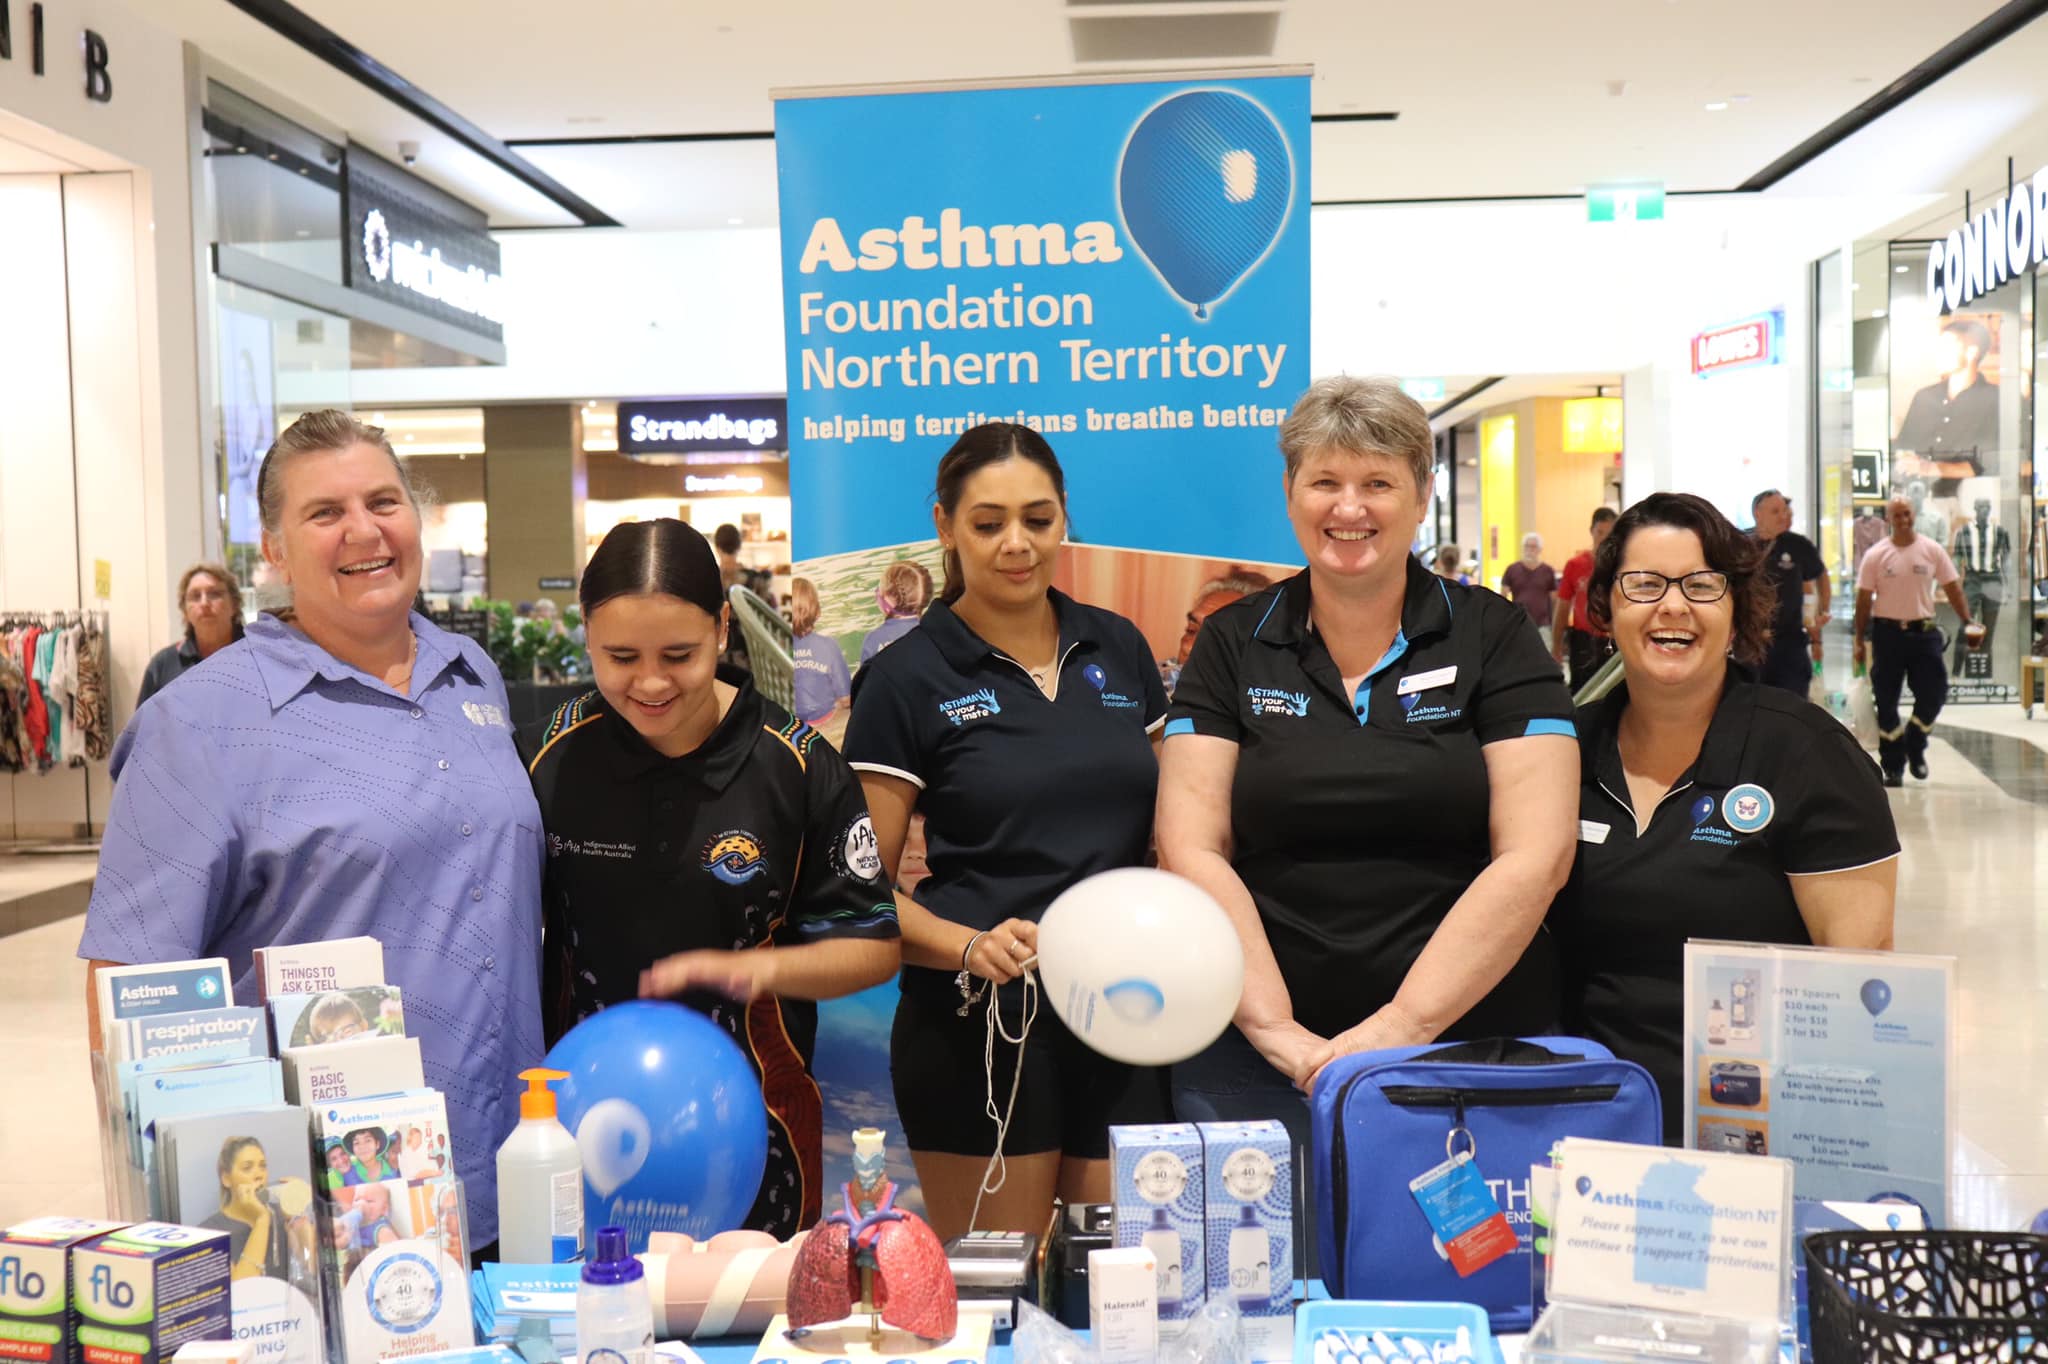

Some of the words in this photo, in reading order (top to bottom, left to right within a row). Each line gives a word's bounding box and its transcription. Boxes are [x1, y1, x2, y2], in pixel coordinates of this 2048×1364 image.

[84, 28, 112, 103] B
[799, 208, 1122, 273] Asthma
[1927, 165, 2048, 318] CONNOR
[799, 283, 1093, 335] Foundation
[801, 341, 1039, 390] Northern
[1060, 333, 1287, 389] Territory
[630, 412, 778, 446] Strandbags
[803, 413, 906, 444] helping
[1086, 405, 1194, 432] breathe
[1202, 403, 1287, 428] better
[1247, 687, 1290, 701] ASTHMA
[939, 693, 978, 713] ASTHMA
[955, 703, 976, 716] your
[1252, 697, 1261, 705] in
[1261, 698, 1285, 707] your
[961, 709, 990, 721] mate
[1265, 704, 1293, 716] mate
[1406, 711, 1450, 723] Foundation
[1450, 709, 1462, 719] NT
[1407, 705, 1447, 717] Asthma
[1692, 825, 1733, 838] Asthma
[583, 840, 617, 850] Indigenous
[618, 843, 637, 852] Allied
[1690, 834, 1733, 846] Foundation
[582, 848, 603, 857] Health
[603, 849, 632, 859] Australia
[280, 966, 320, 980] THINGS
[322, 966, 336, 978] TO
[119, 984, 178, 1001] Asthma
[281, 981, 303, 993] ASK
[305, 981, 314, 992] &
[315, 979, 340, 991] TELL
[1805, 1002, 1828, 1012] each
[145, 1016, 259, 1042] respiratory
[311, 1071, 345, 1087] BASIC
[312, 1085, 348, 1101] FACTS
[338, 1112, 381, 1125] Asthma
[1152, 1169, 1167, 1180] 40
[1241, 1167, 1256, 1177] 40
[1591, 1191, 1665, 1211] Asthma
[1667, 1199, 1753, 1222] Foundation
[1756, 1209, 1778, 1225] NT
[1580, 1215, 1621, 1233] Please
[1624, 1221, 1675, 1240] support
[1720, 1234, 1739, 1246] we
[1743, 1238, 1768, 1249] can
[1567, 1235, 1622, 1253] continue
[1626, 1241, 1638, 1254] to
[1642, 1244, 1693, 1262] support
[1695, 1249, 1779, 1273] Territorians.
[0, 1255, 45, 1300] flo
[88, 1263, 134, 1308] flo
[1104, 1298, 1145, 1311] Haleraid
[391, 1332, 437, 1350] Helping
